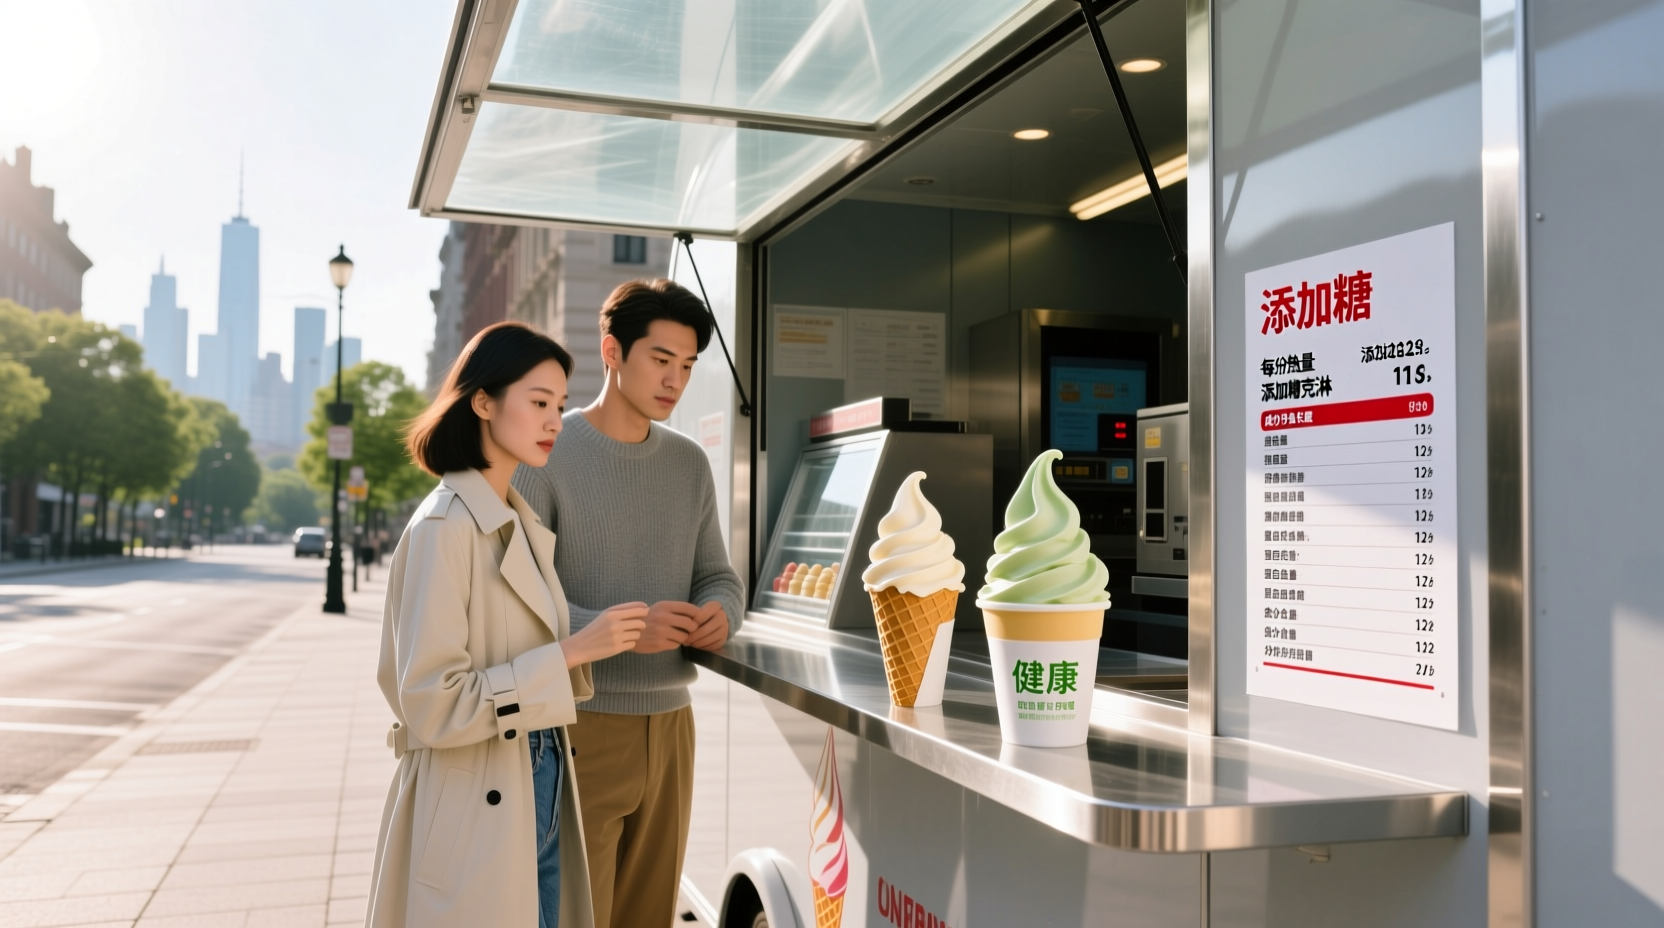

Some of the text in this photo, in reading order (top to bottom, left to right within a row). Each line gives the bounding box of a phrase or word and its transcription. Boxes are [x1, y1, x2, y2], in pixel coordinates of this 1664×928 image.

[1261, 270, 1373, 335] 添加糖
[1012, 659, 1079, 695] 健康
